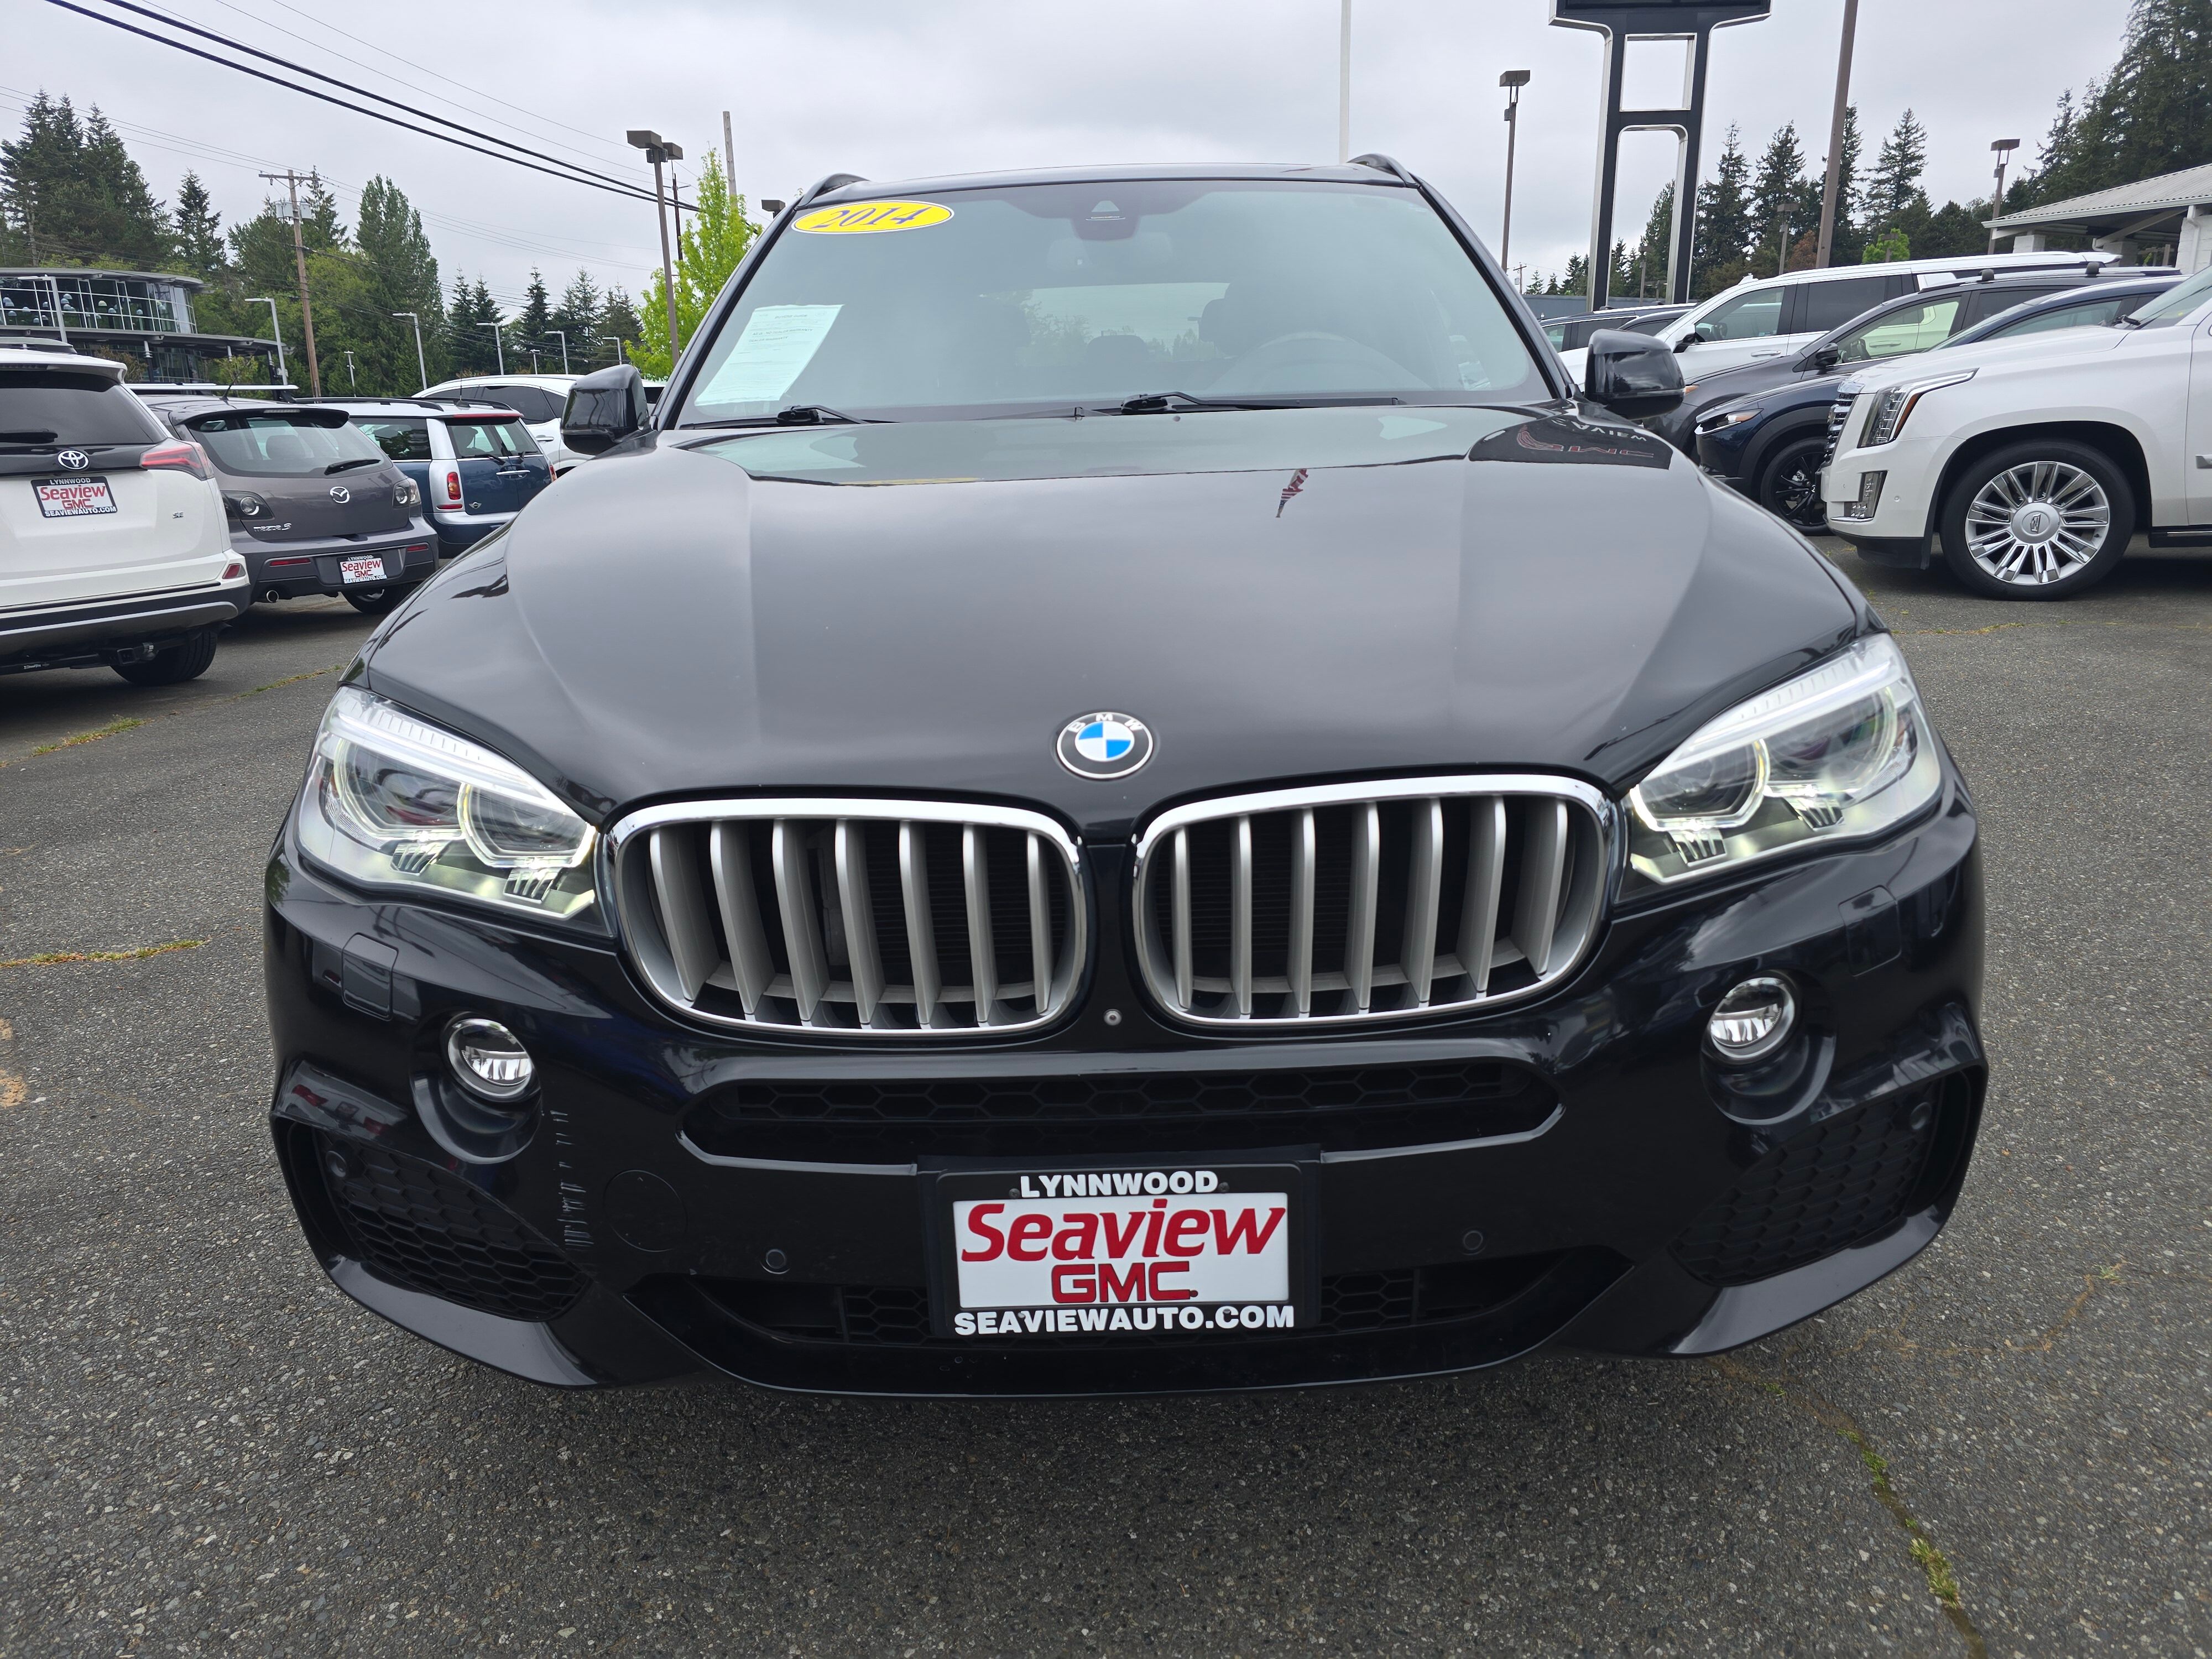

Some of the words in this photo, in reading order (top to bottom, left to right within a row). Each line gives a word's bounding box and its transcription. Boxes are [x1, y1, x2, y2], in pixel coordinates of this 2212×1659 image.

[810, 207, 933, 229] 2014
[40, 485, 106, 500] Seaview
[45, 507, 116, 517] SEAVIEWAUTO.COM
[61, 499, 94, 510] GMC
[342, 560, 381, 572] Seaview
[1067, 713, 1144, 733] BMW
[1020, 1171, 1218, 1198] LYNNWOOD
[961, 1198, 1286, 1262] Seaview
[1052, 1261, 1190, 1304] GMC
[954, 1306, 1295, 1335] SEAVIEWAUTO.COM
